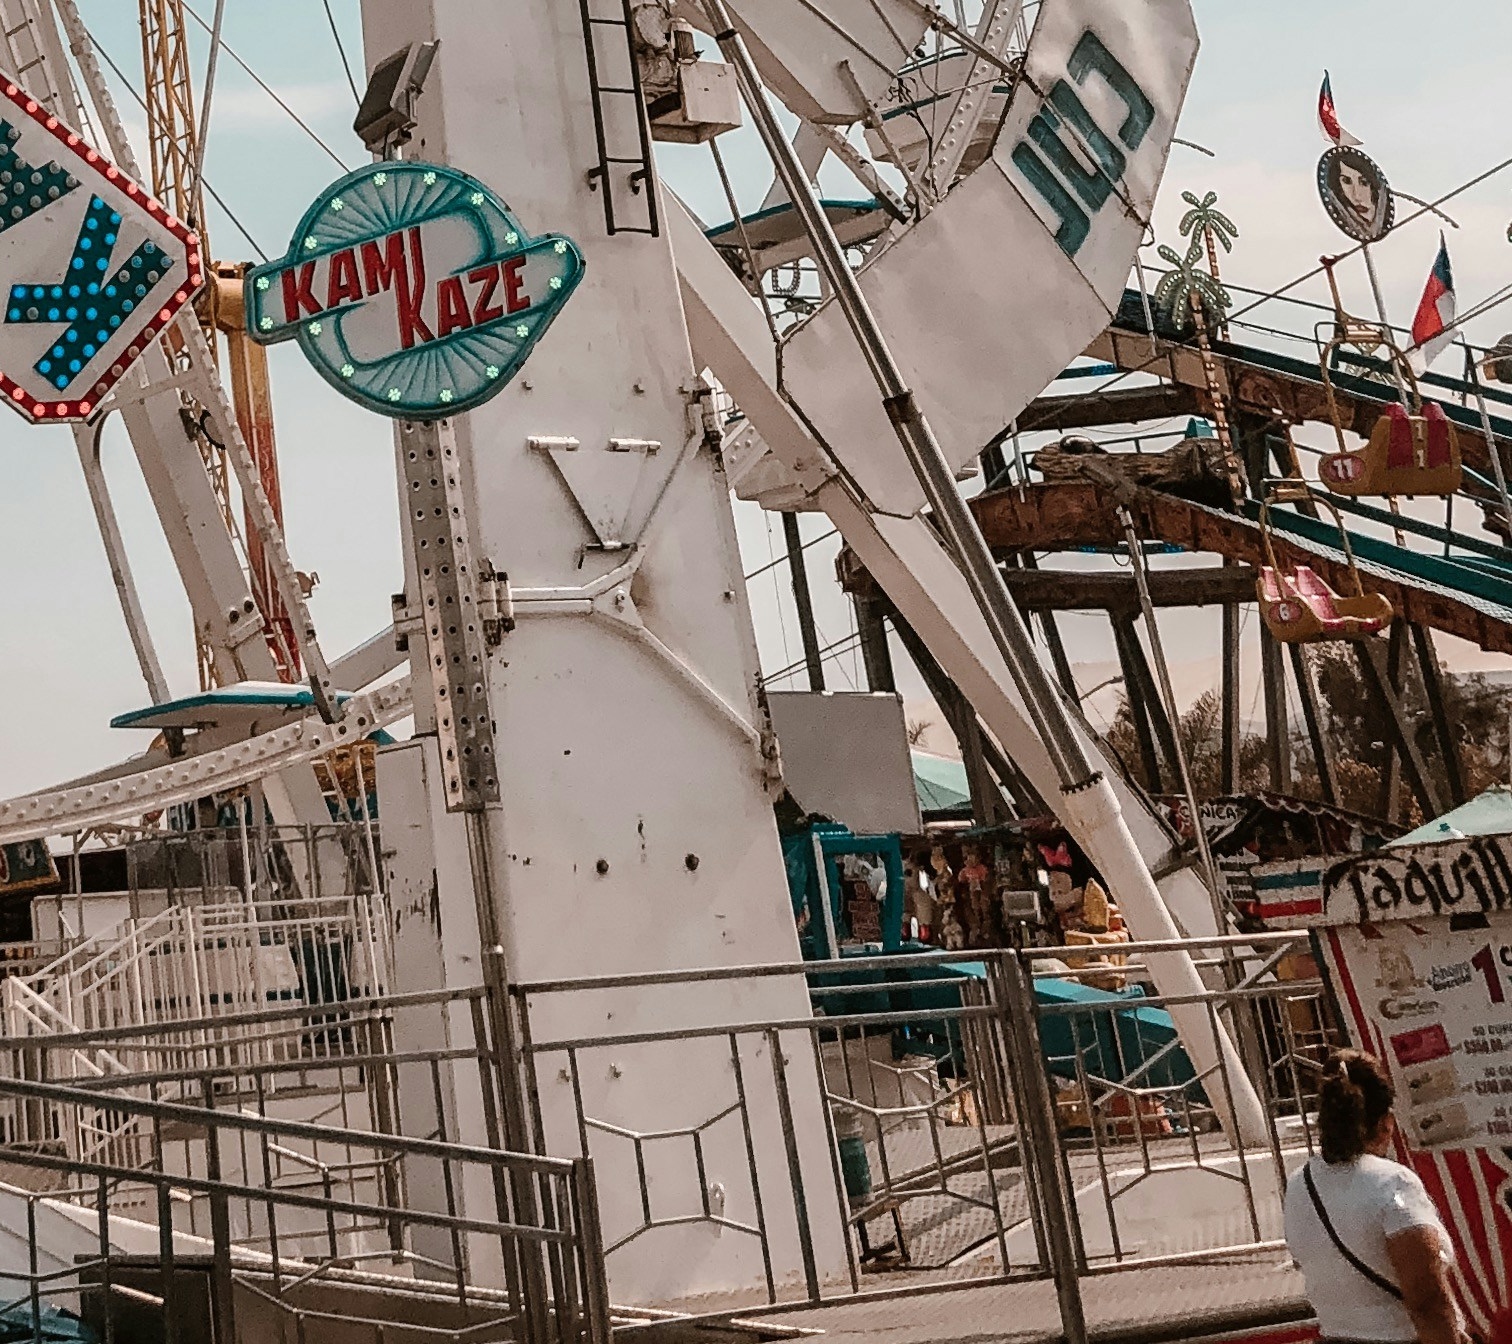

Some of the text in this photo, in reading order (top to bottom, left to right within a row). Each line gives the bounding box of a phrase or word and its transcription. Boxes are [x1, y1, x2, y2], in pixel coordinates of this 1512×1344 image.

[280, 226, 425, 323] KAMI
[396, 255, 531, 350] KAZE
[1333, 458, 1355, 480] 11
[1471, 943, 1505, 1003] 1
